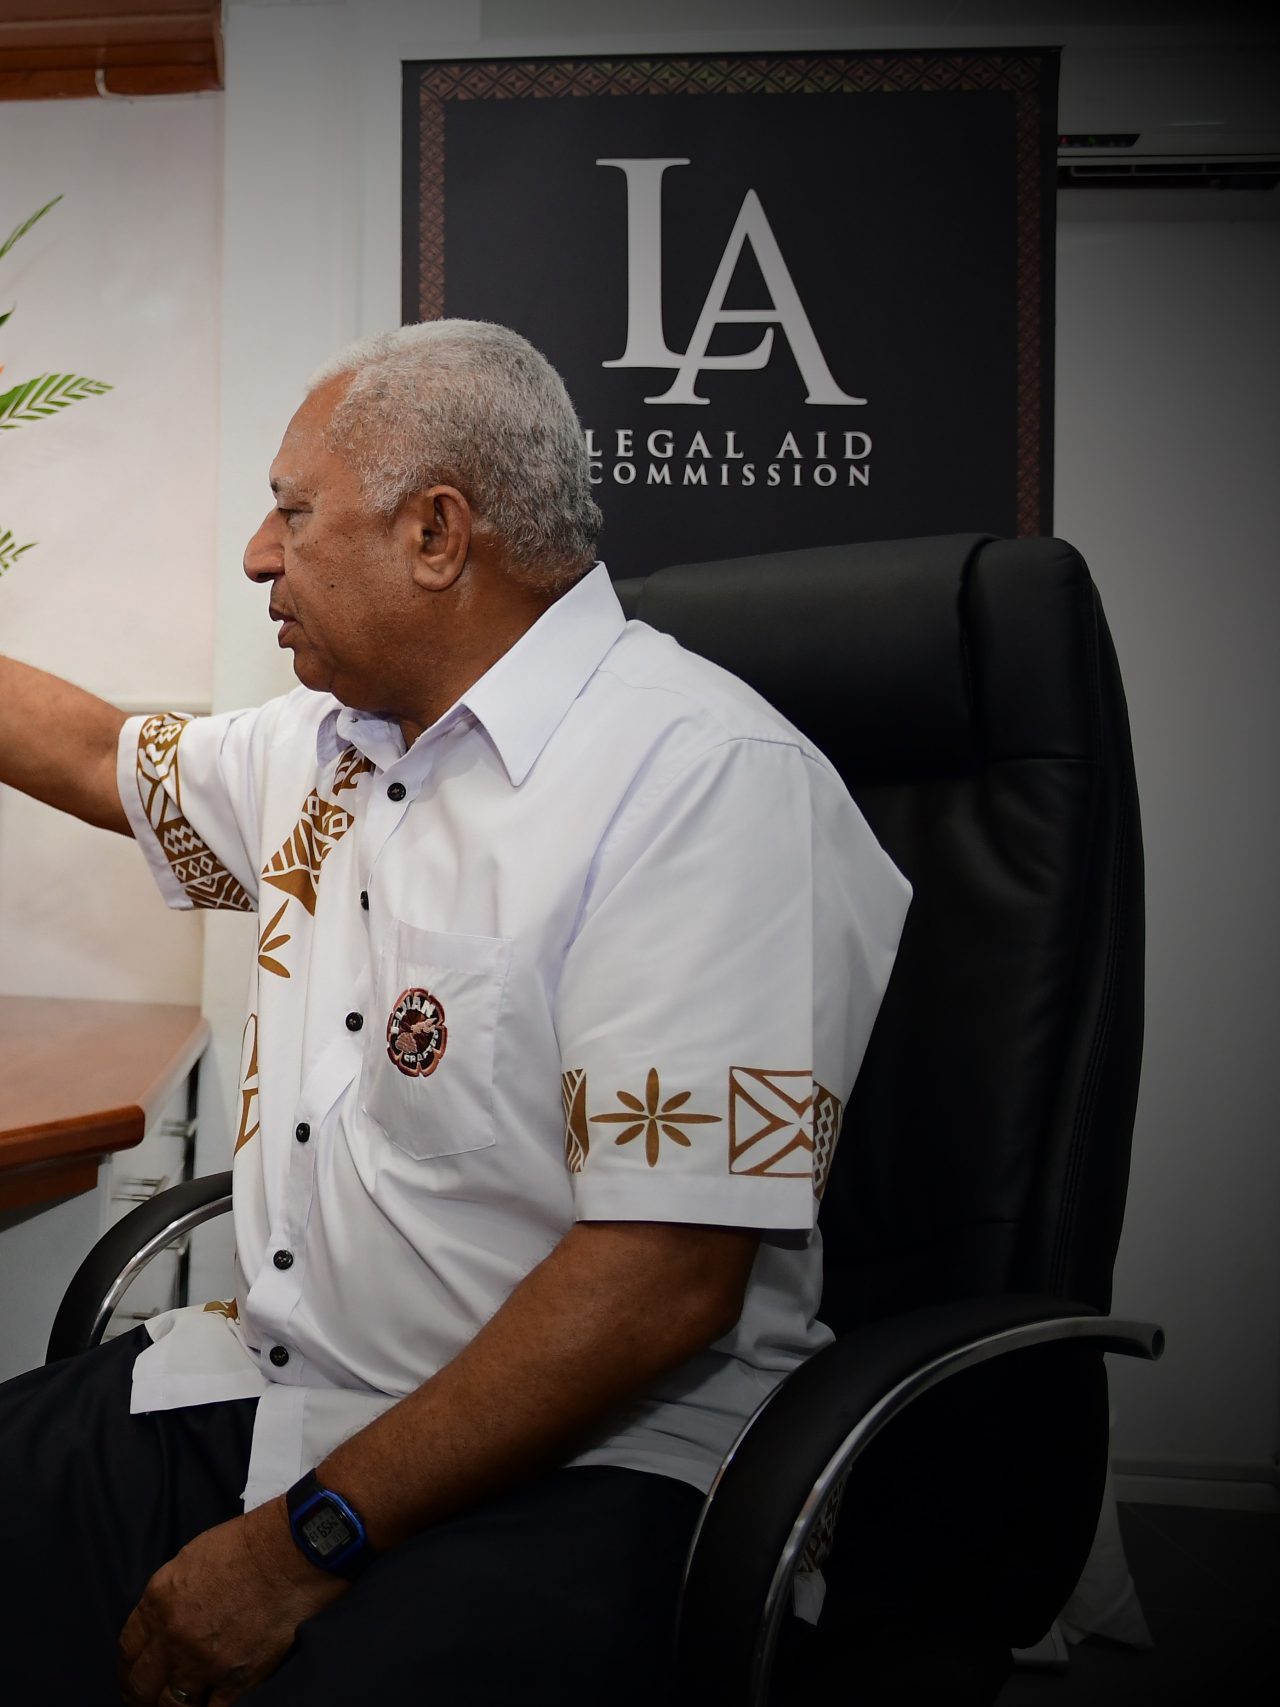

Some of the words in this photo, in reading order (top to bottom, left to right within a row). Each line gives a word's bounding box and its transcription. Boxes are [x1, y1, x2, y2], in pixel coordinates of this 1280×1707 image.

[595, 156, 868, 406] LA
[586, 429, 745, 460] LEGAL
[776, 429, 874, 461] AID
[588, 462, 872, 488] COMMISSION
[390, 995, 436, 1035] FIJIAN
